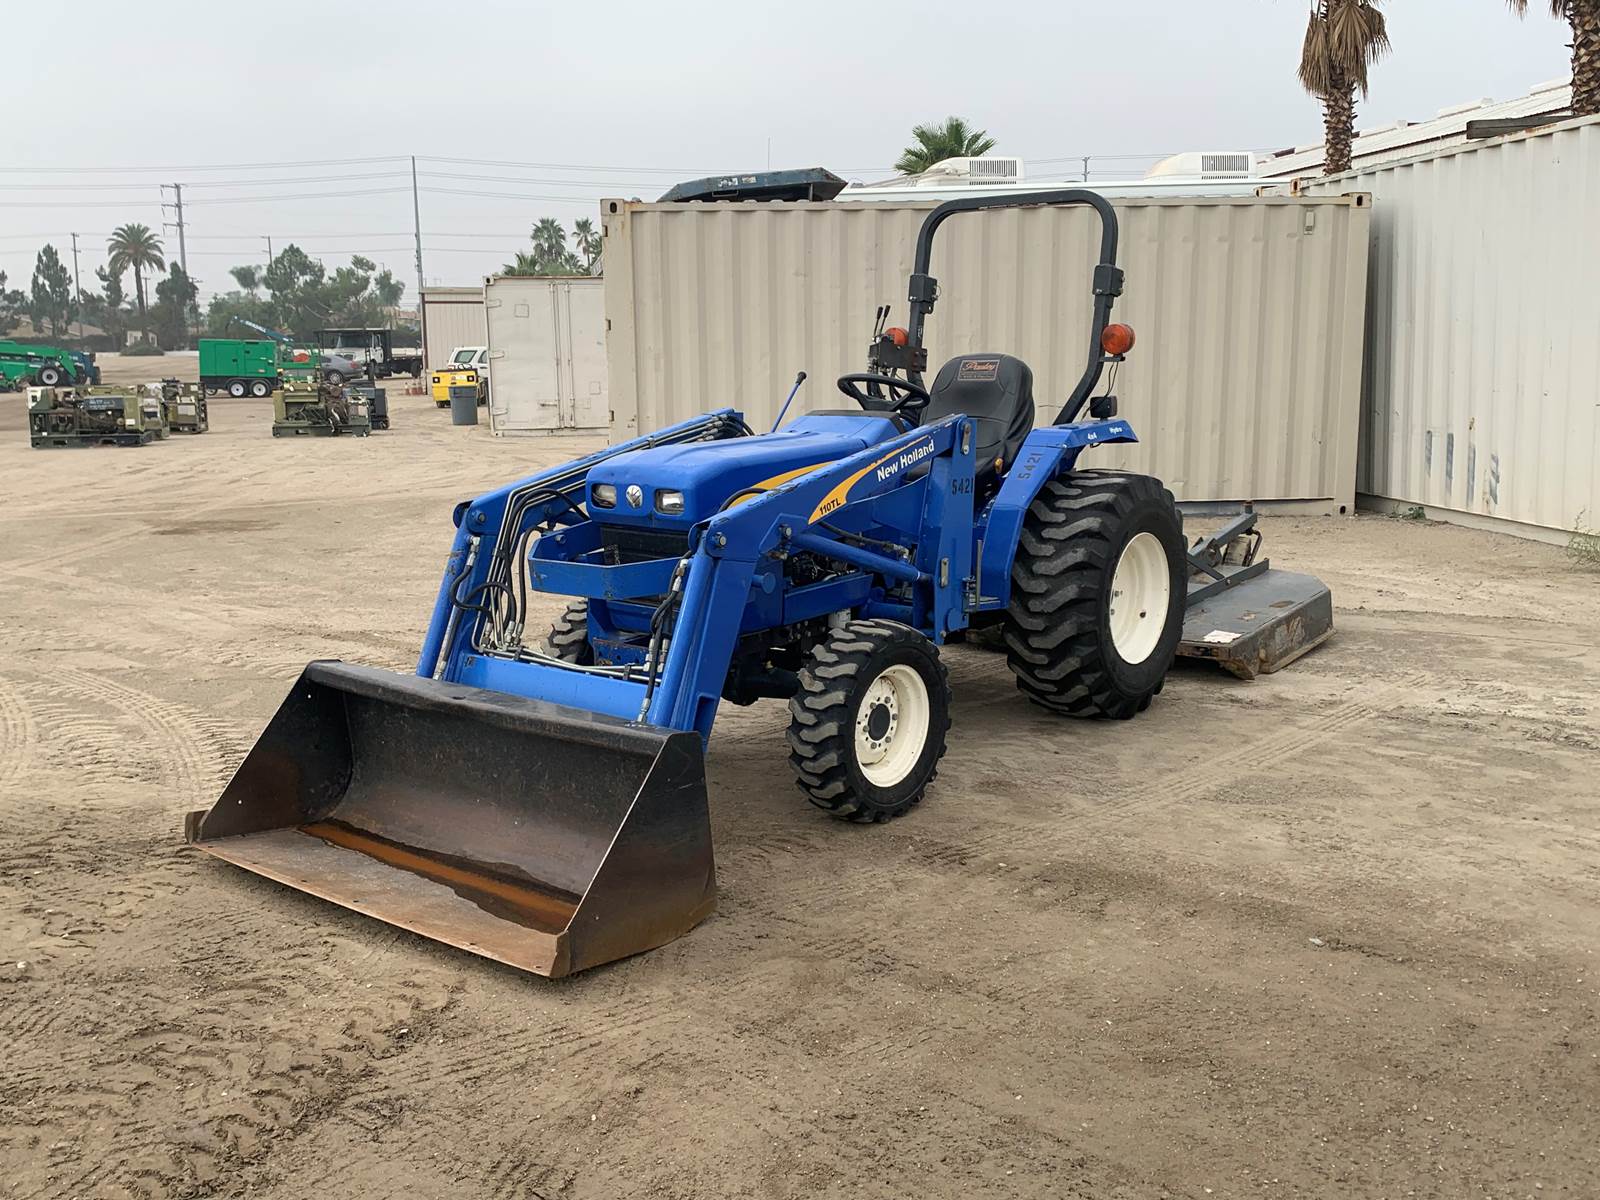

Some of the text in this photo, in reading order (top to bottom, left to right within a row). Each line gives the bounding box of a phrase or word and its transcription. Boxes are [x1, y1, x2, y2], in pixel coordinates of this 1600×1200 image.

[877, 439, 935, 482] New Holland
[1017, 453, 1045, 479] 5421
[952, 477, 974, 496] 5421
[820, 498, 842, 515] 110TL
